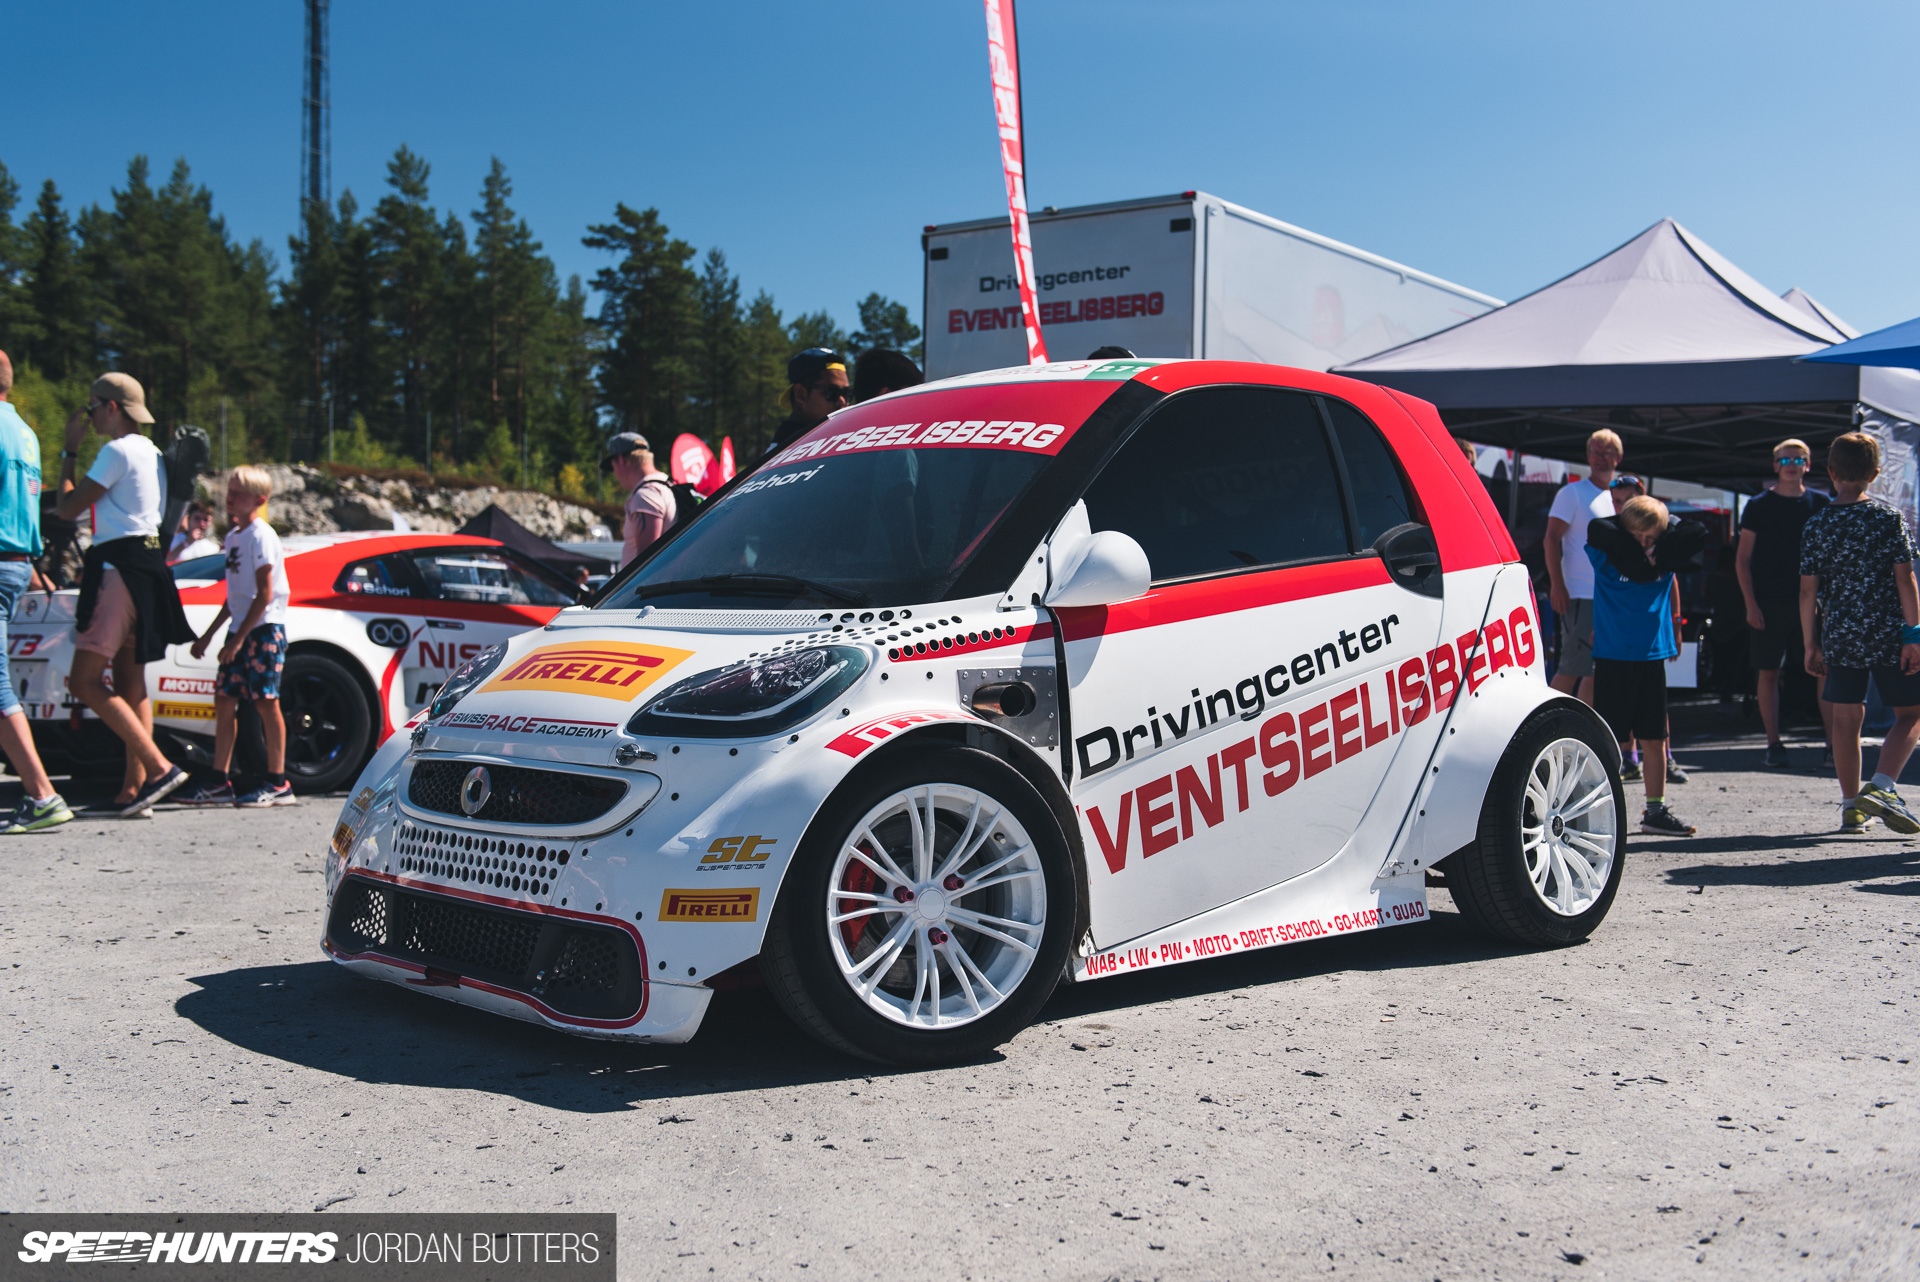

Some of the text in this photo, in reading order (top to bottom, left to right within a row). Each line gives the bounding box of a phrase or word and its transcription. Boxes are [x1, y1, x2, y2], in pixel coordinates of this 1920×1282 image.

[978, 265, 1131, 293] Drivngcenter
[947, 291, 1165, 334] EVENTEELISBERG
[758, 420, 1066, 472] VENTSEELISBERG
[726, 464, 825, 500] Schori
[162, 678, 216, 693] MOTUL
[500, 650, 665, 688] PIRELLI
[1075, 613, 1400, 780] Drivingcenter
[452, 712, 614, 739] SWISS RACE ACADEMY
[1076, 606, 1536, 876] VENTSEELISBERG
[667, 893, 752, 916] PIRELLI
[1085, 900, 1425, 976] WAB LW PW MOTO DRIFT-SCHOOL GO-KART QUAD
